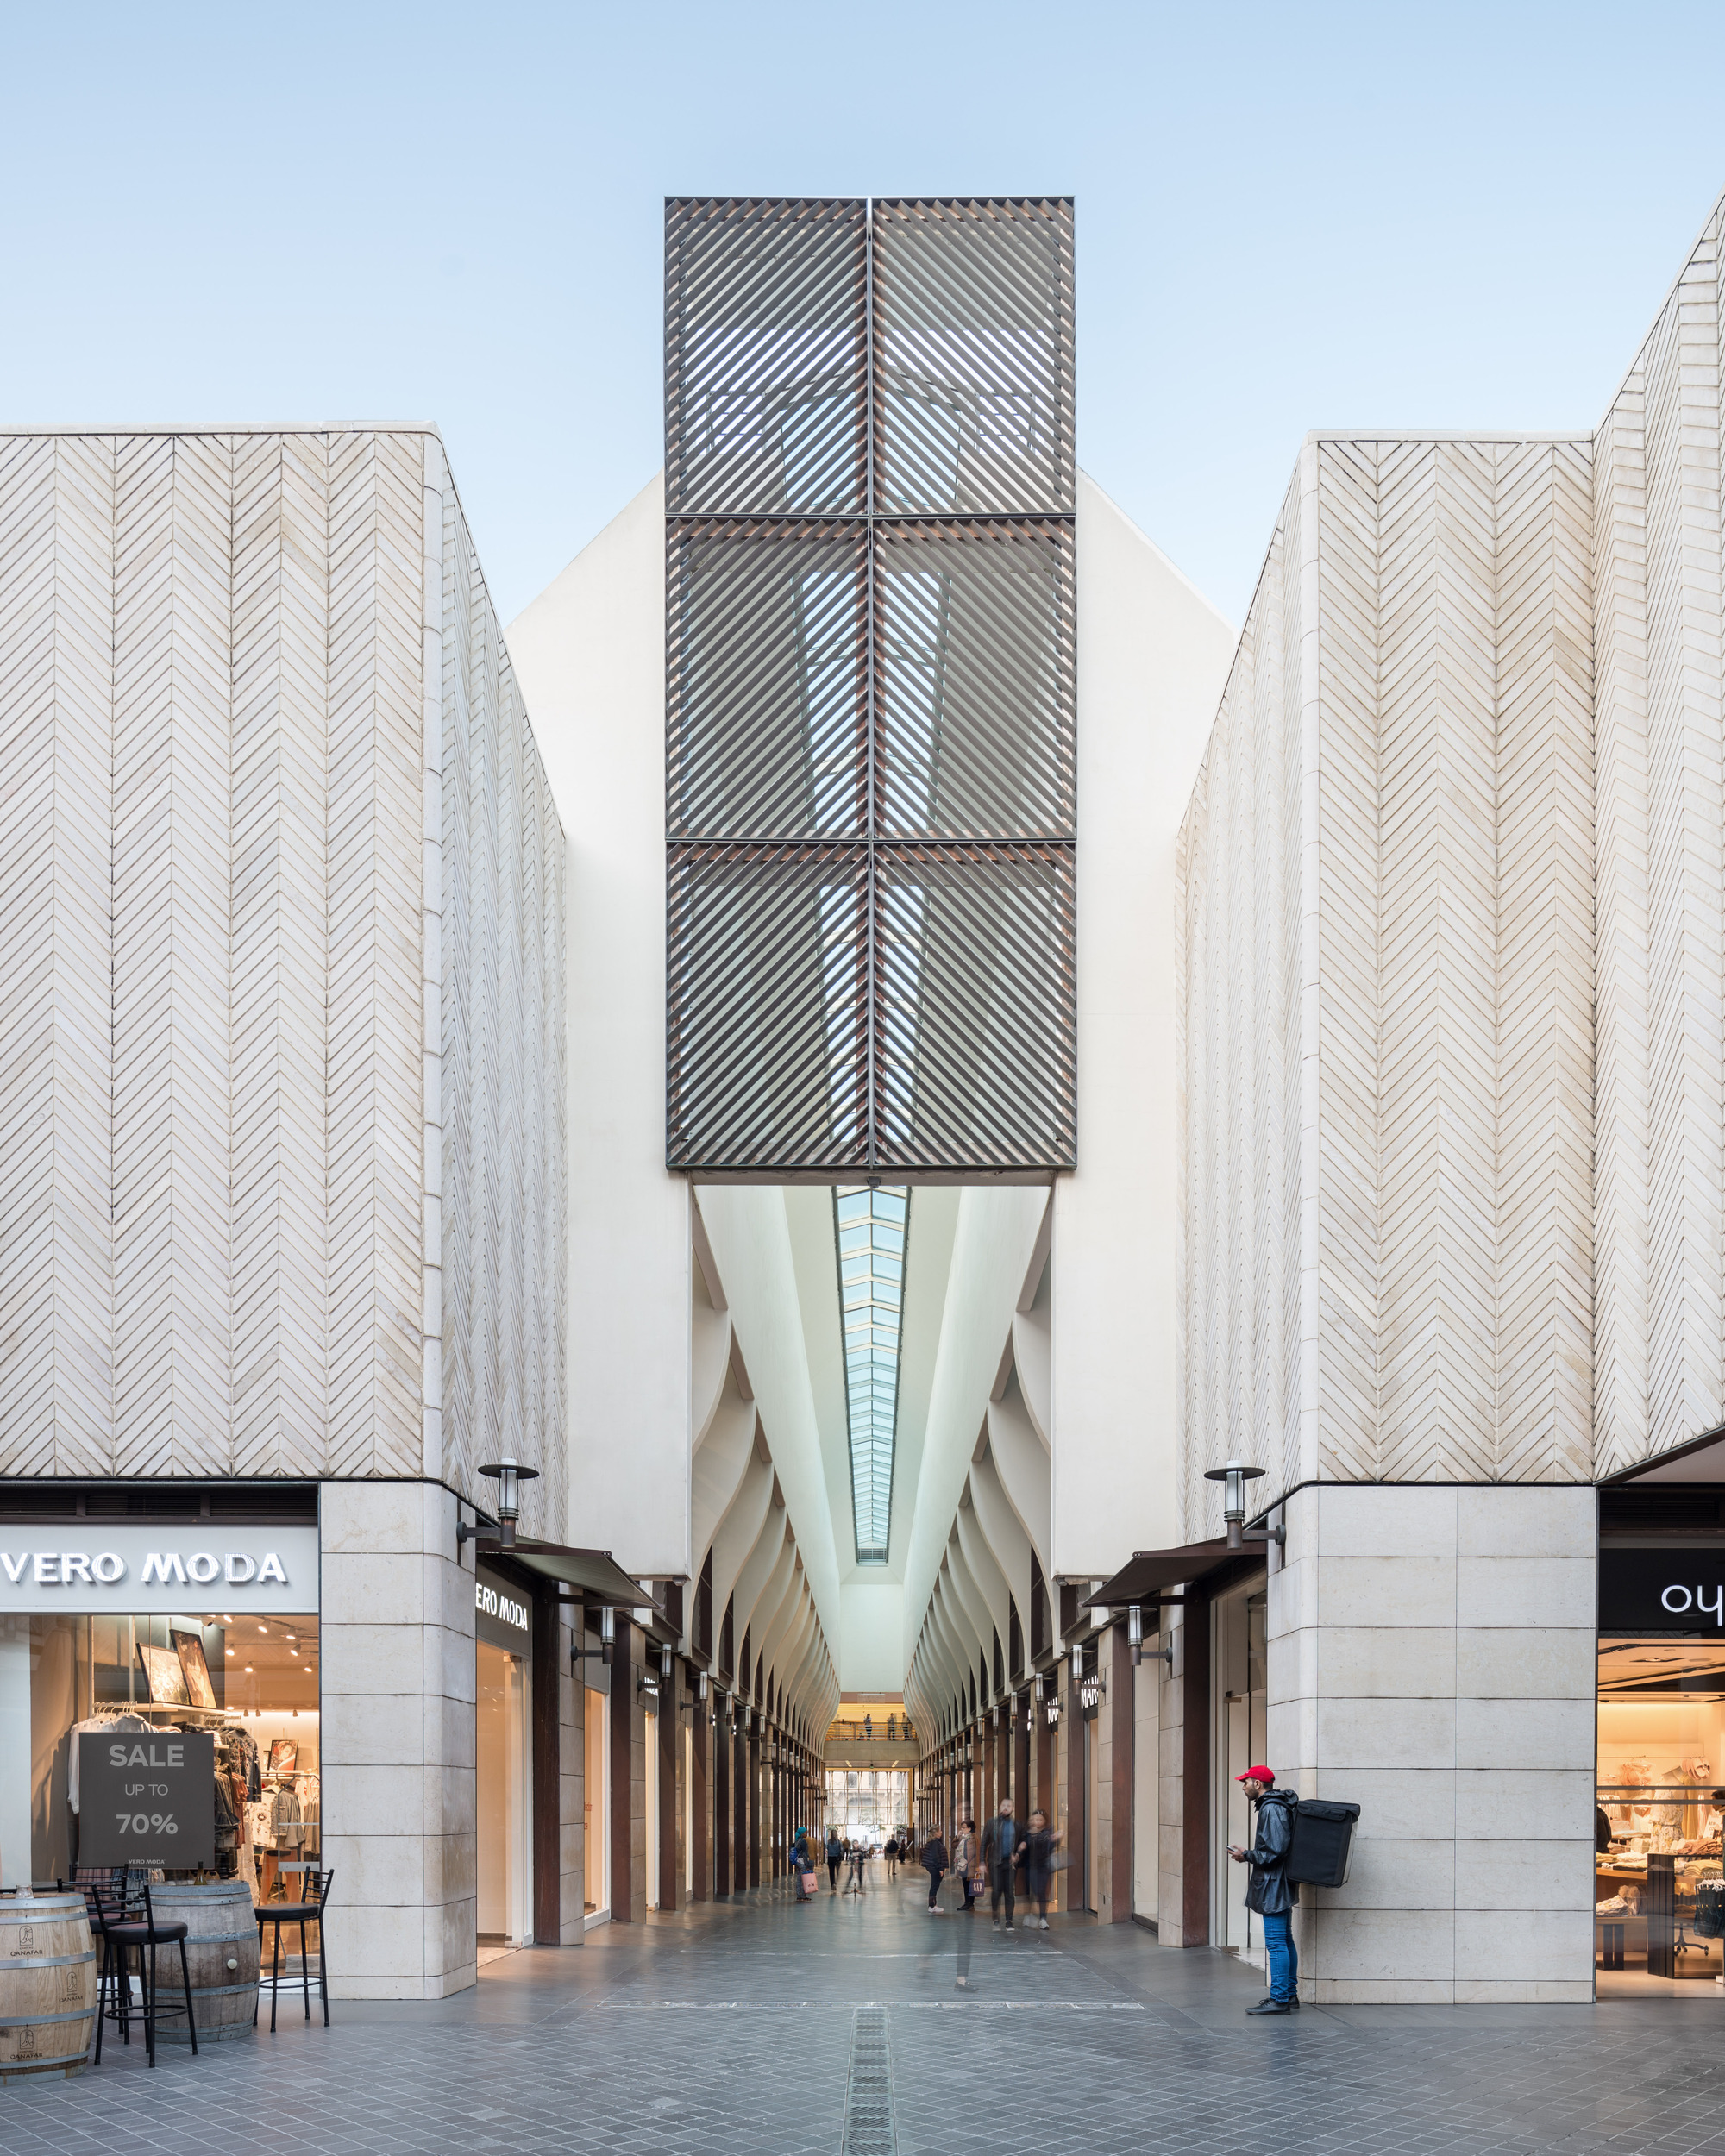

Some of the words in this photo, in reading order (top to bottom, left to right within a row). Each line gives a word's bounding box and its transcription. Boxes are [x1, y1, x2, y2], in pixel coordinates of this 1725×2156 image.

[1, 1552, 127, 1583] VERO
[141, 1552, 287, 1583] MODA
[499, 1595, 528, 1631] MODA
[1081, 1675, 1098, 1709] MAN
[109, 1745, 185, 1767] SALE
[125, 1783, 145, 1796] UP
[147, 1783, 169, 1796] TO
[116, 1814, 179, 1834] 70%
